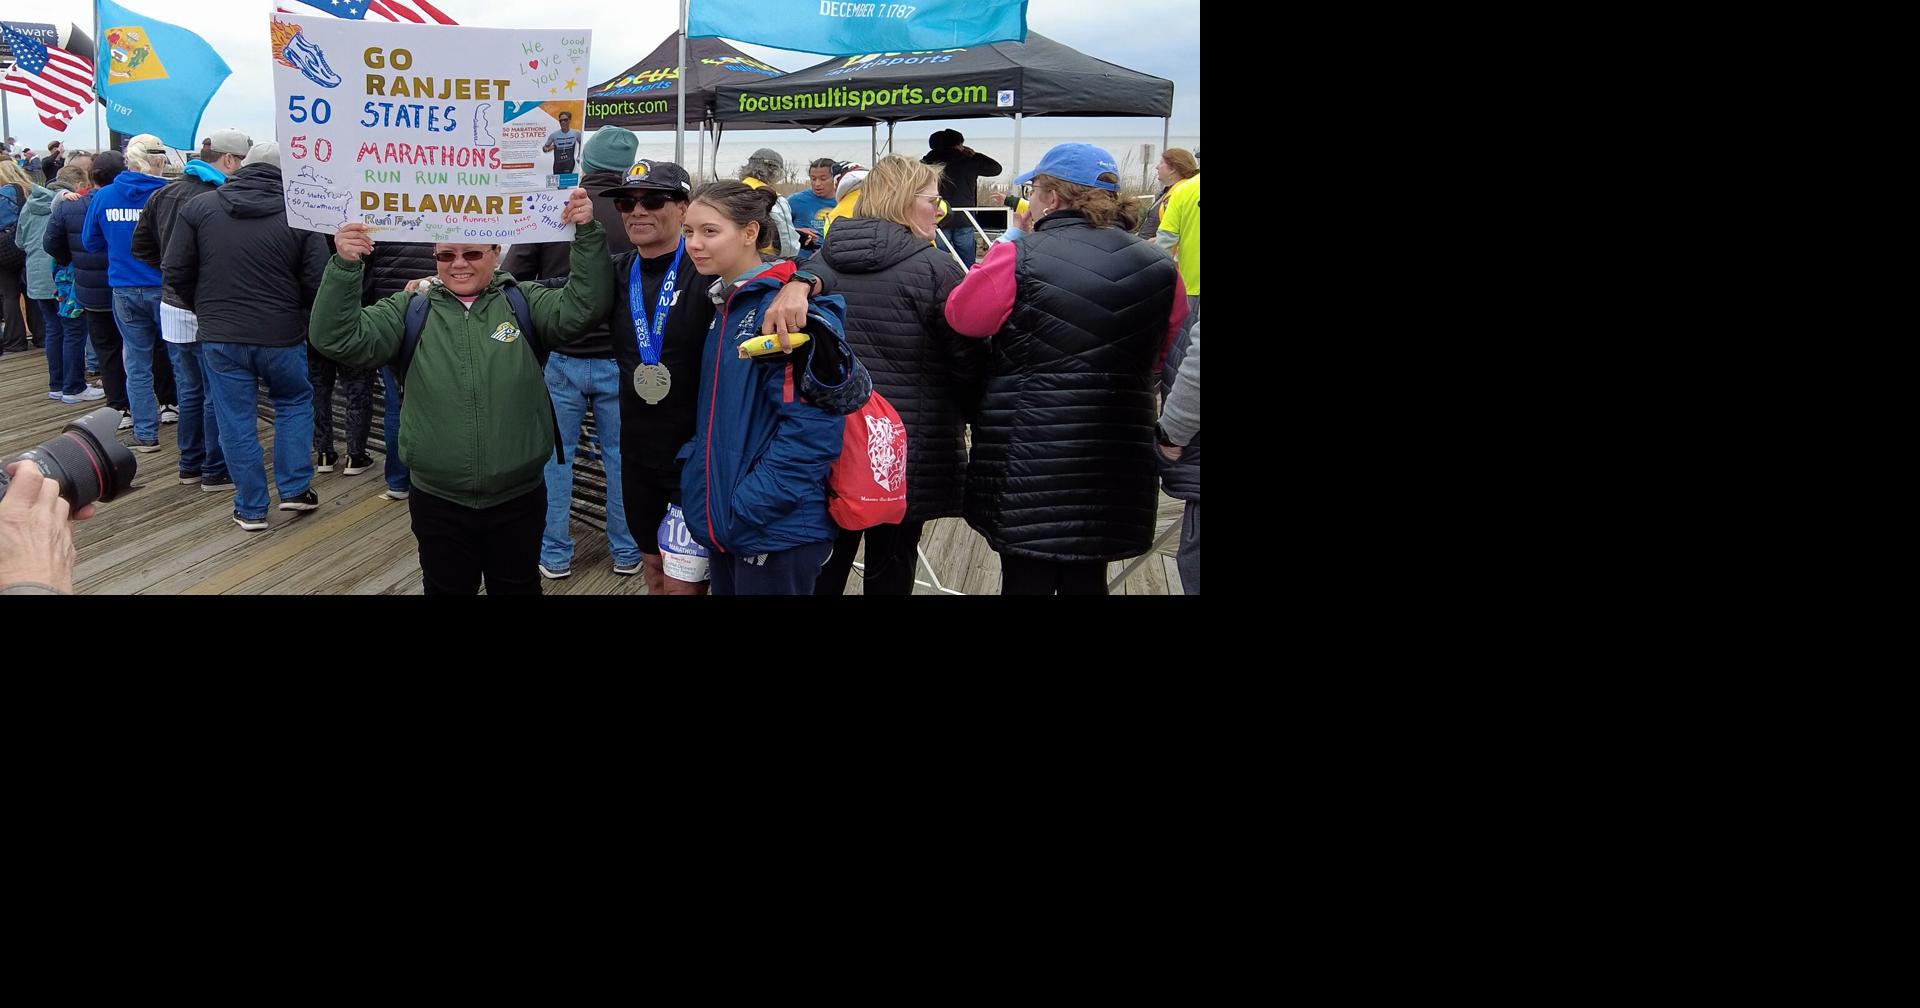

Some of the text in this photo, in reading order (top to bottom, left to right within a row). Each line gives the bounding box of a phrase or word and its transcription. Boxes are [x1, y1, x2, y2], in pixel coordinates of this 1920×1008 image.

[819, 0, 875, 17] DECEMBER
[887, 4, 916, 19] 1787
[0, 24, 54, 37] laware
[364, 47, 412, 70] GO
[366, 74, 510, 100] RANJEET
[739, 84, 988, 111] focusmultisports.com
[289, 95, 331, 124] 50
[361, 101, 456, 132] STATES
[586, 100, 668, 119] tisports.com
[290, 136, 332, 162] 50
[357, 142, 502, 169] MARATHONS
[365, 169, 400, 183] RUN
[416, 171, 448, 185] RUN
[457, 172, 498, 187] RUN!
[294, 187, 305, 195] 50
[360, 191, 523, 214] DELAWARE
[365, 213, 391, 226] Run
[464, 229, 476, 237] GO
[479, 229, 492, 237] GO
[659, 270, 677, 306] 26.2
[635, 318, 647, 348] 2025
[667, 518, 704, 549] 10
[668, 543, 697, 556] MARATHON
